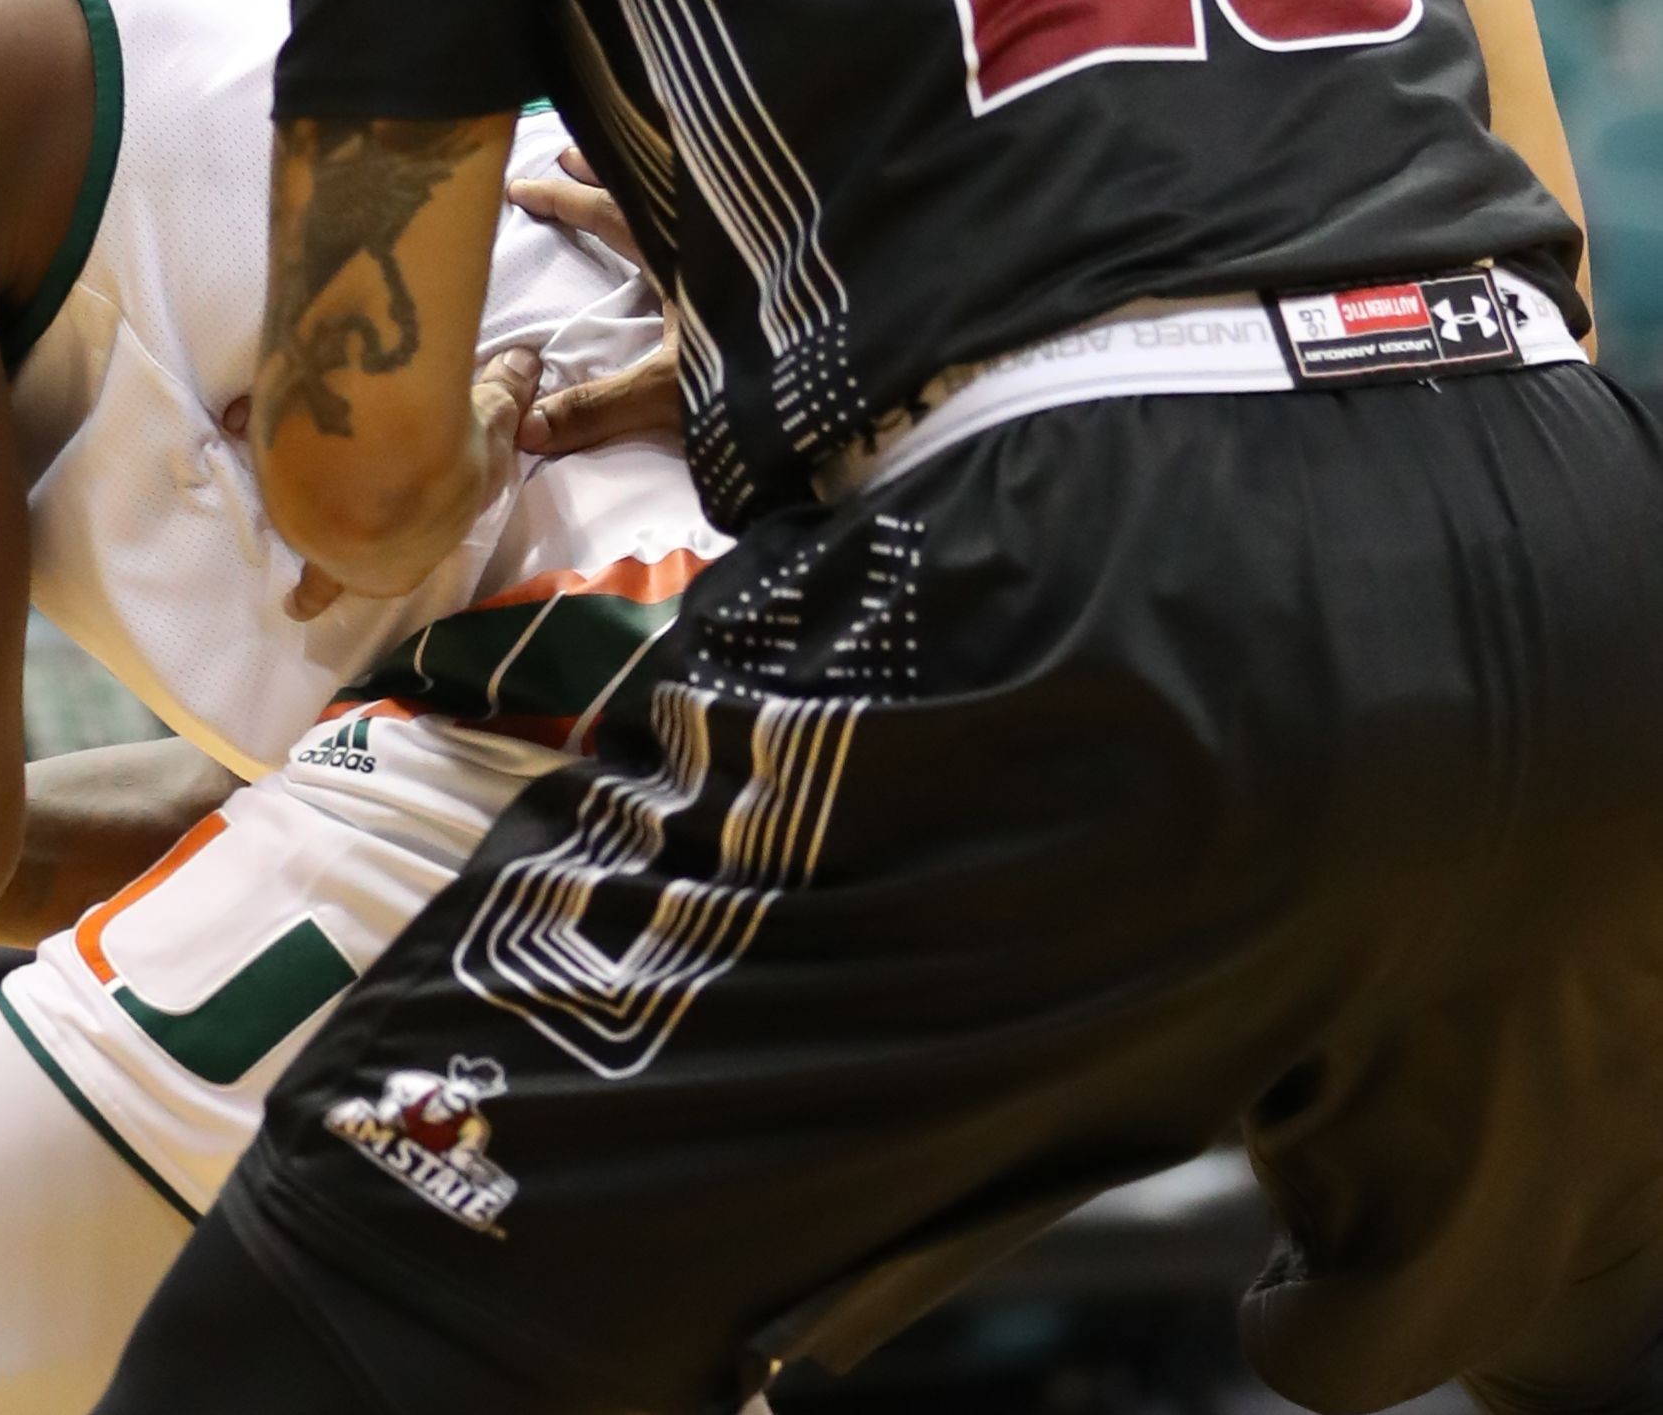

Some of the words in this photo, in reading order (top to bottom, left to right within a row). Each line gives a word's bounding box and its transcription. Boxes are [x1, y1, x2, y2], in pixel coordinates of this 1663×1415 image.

[1340, 295, 1420, 322] AUTHENTIC
[1133, 320, 1268, 349] UNDER
[1379, 338, 1433, 354] UNDER
[1303, 344, 1376, 363] ARMOUR
[297, 747, 377, 774] adidas
[388, 1137, 504, 1222] STATE
